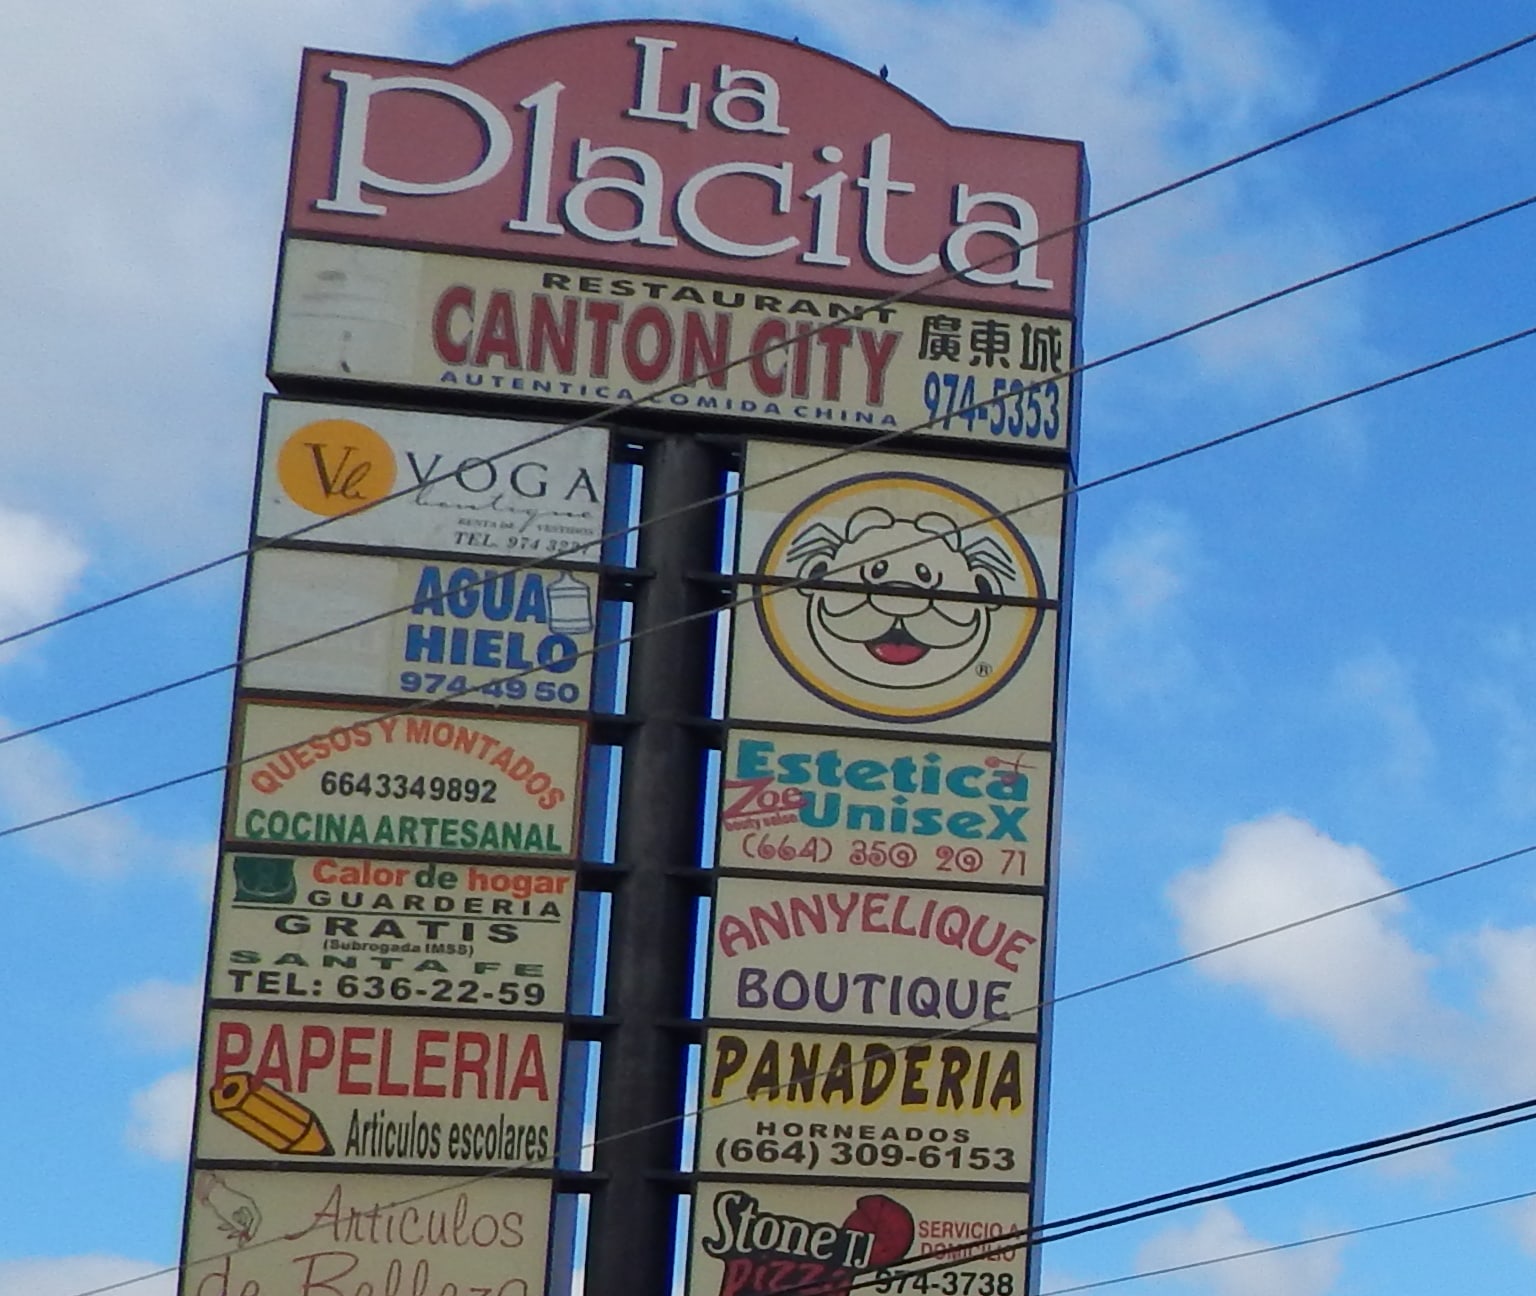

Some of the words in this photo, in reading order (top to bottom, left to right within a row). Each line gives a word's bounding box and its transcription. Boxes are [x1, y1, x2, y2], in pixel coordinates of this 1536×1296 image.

[626, 36, 790, 136] La
[313, 69, 1054, 292] Placita
[542, 272, 898, 324] RESTAURANT
[432, 285, 732, 391] CANTON
[748, 317, 903, 407] CITY
[918, 314, 1062, 373] 廣東城
[441, 369, 633, 401] AUTENTICA
[793, 405, 899, 427] CHINA
[924, 371, 1060, 440] 974-5353
[405, 450, 600, 503] VOGA
[455, 531, 499, 548] TEL.
[506, 536, 540, 550] 974
[412, 566, 547, 624] AGUA
[405, 624, 578, 673] HIELO
[250, 722, 373, 797] QUESOS
[380, 718, 402, 744] Y
[406, 718, 566, 811] MONTADOS
[737, 738, 1029, 802] Estetica
[722, 776, 808, 818] Zoe
[245, 808, 368, 844] COCINA
[374, 815, 562, 852] ARTESANAL
[742, 833, 833, 863] (664)
[1001, 849, 1027, 876] 71
[307, 890, 561, 917] GUARDERIA
[312, 858, 411, 888] Calor
[415, 864, 459, 891] de
[468, 867, 571, 899] hogar
[275, 914, 519, 945] GRATIS
[323, 939, 421, 955] (Subrogada
[719, 892, 1037, 973] ANNYELIQUE
[227, 969, 322, 997] TEL:
[337, 974, 546, 1007] 636-22-59
[229, 950, 448, 974] SANTA
[474, 962, 545, 978] FE
[737, 967, 1012, 1021] BOUTIQUE
[214, 1021, 549, 1101] PAPELERIA
[711, 1035, 1025, 1113] PANADERIA
[346, 1108, 441, 1159] Articulos
[448, 1114, 549, 1161] escolares
[716, 1137, 819, 1170] (664)
[830, 1142, 1016, 1171] 309-6153
[756, 1121, 971, 1144] HORNEADOS
[285, 1184, 524, 1248] Articulos
[704, 1191, 837, 1260] Stone
[842, 1230, 876, 1269] TJ
[918, 1220, 1003, 1240] SERVICIO
[875, 1270, 1014, 1296] 974-3738
